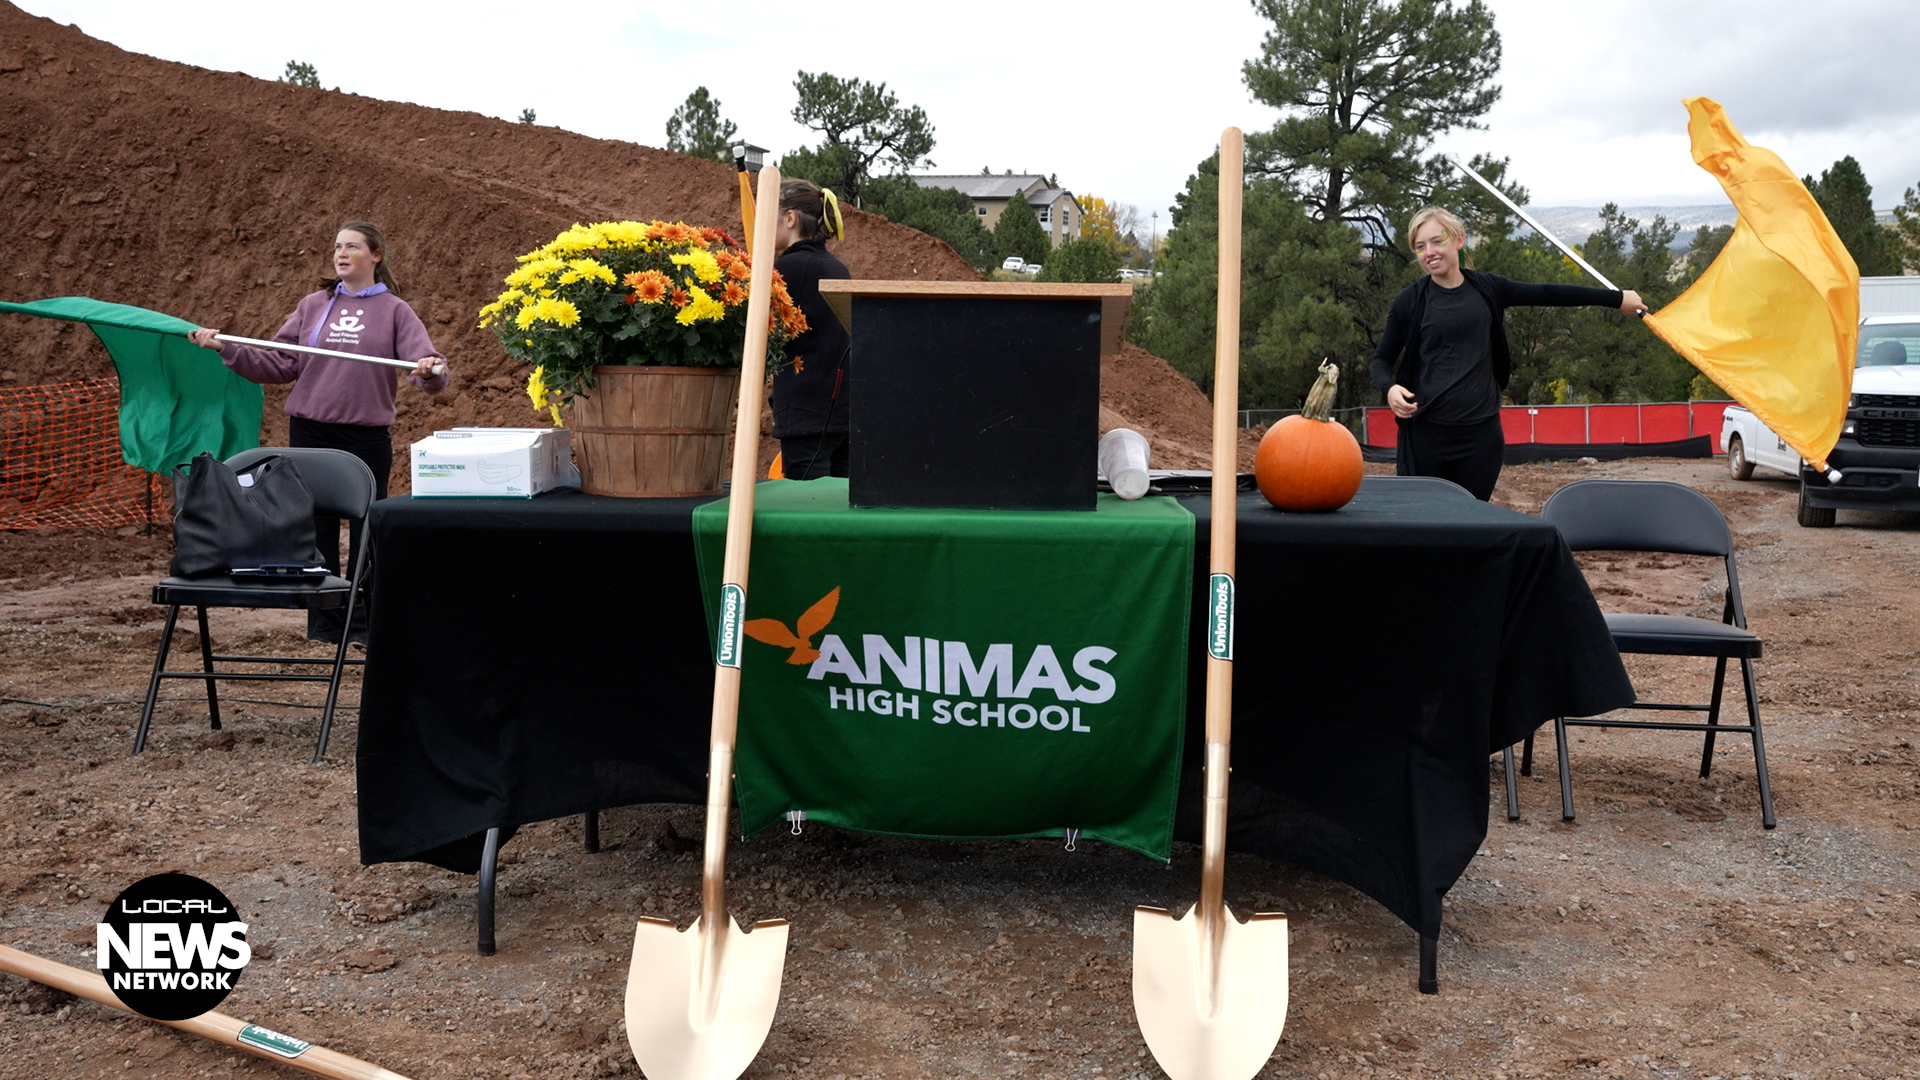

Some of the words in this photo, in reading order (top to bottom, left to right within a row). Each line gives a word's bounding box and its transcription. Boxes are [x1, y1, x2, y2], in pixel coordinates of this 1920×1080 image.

[720, 591, 738, 661] UnionTools
[1213, 582, 1229, 653] UnionTools
[806, 633, 1118, 704] ANIMAS
[828, 686, 920, 720] HIGH
[932, 699, 1091, 733] SCHOOL
